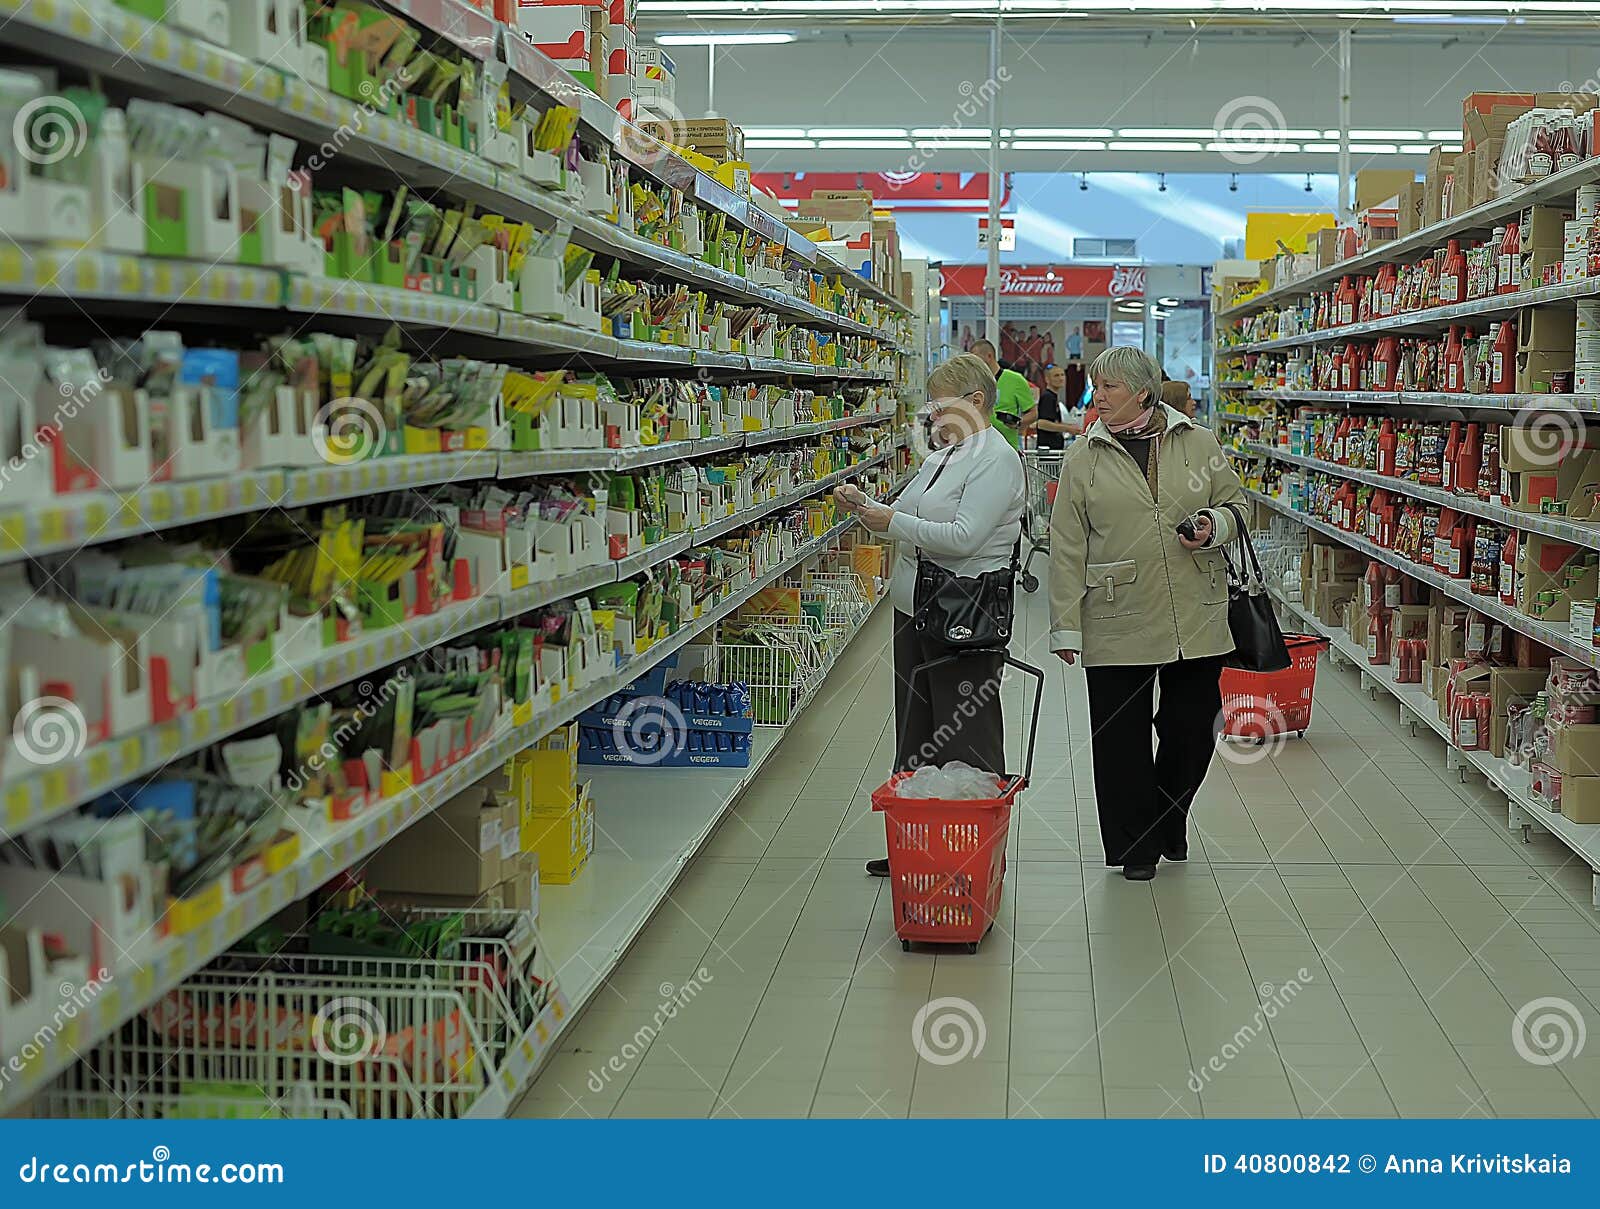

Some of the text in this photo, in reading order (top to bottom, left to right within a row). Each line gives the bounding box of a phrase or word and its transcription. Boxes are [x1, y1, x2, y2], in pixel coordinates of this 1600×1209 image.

[1000, 269, 1064, 293] Biarma
[602, 718, 632, 727] VEGETA
[692, 718, 722, 727] VEGETA
[603, 754, 632, 762] VEGETA
[690, 755, 720, 763] VEGETA
